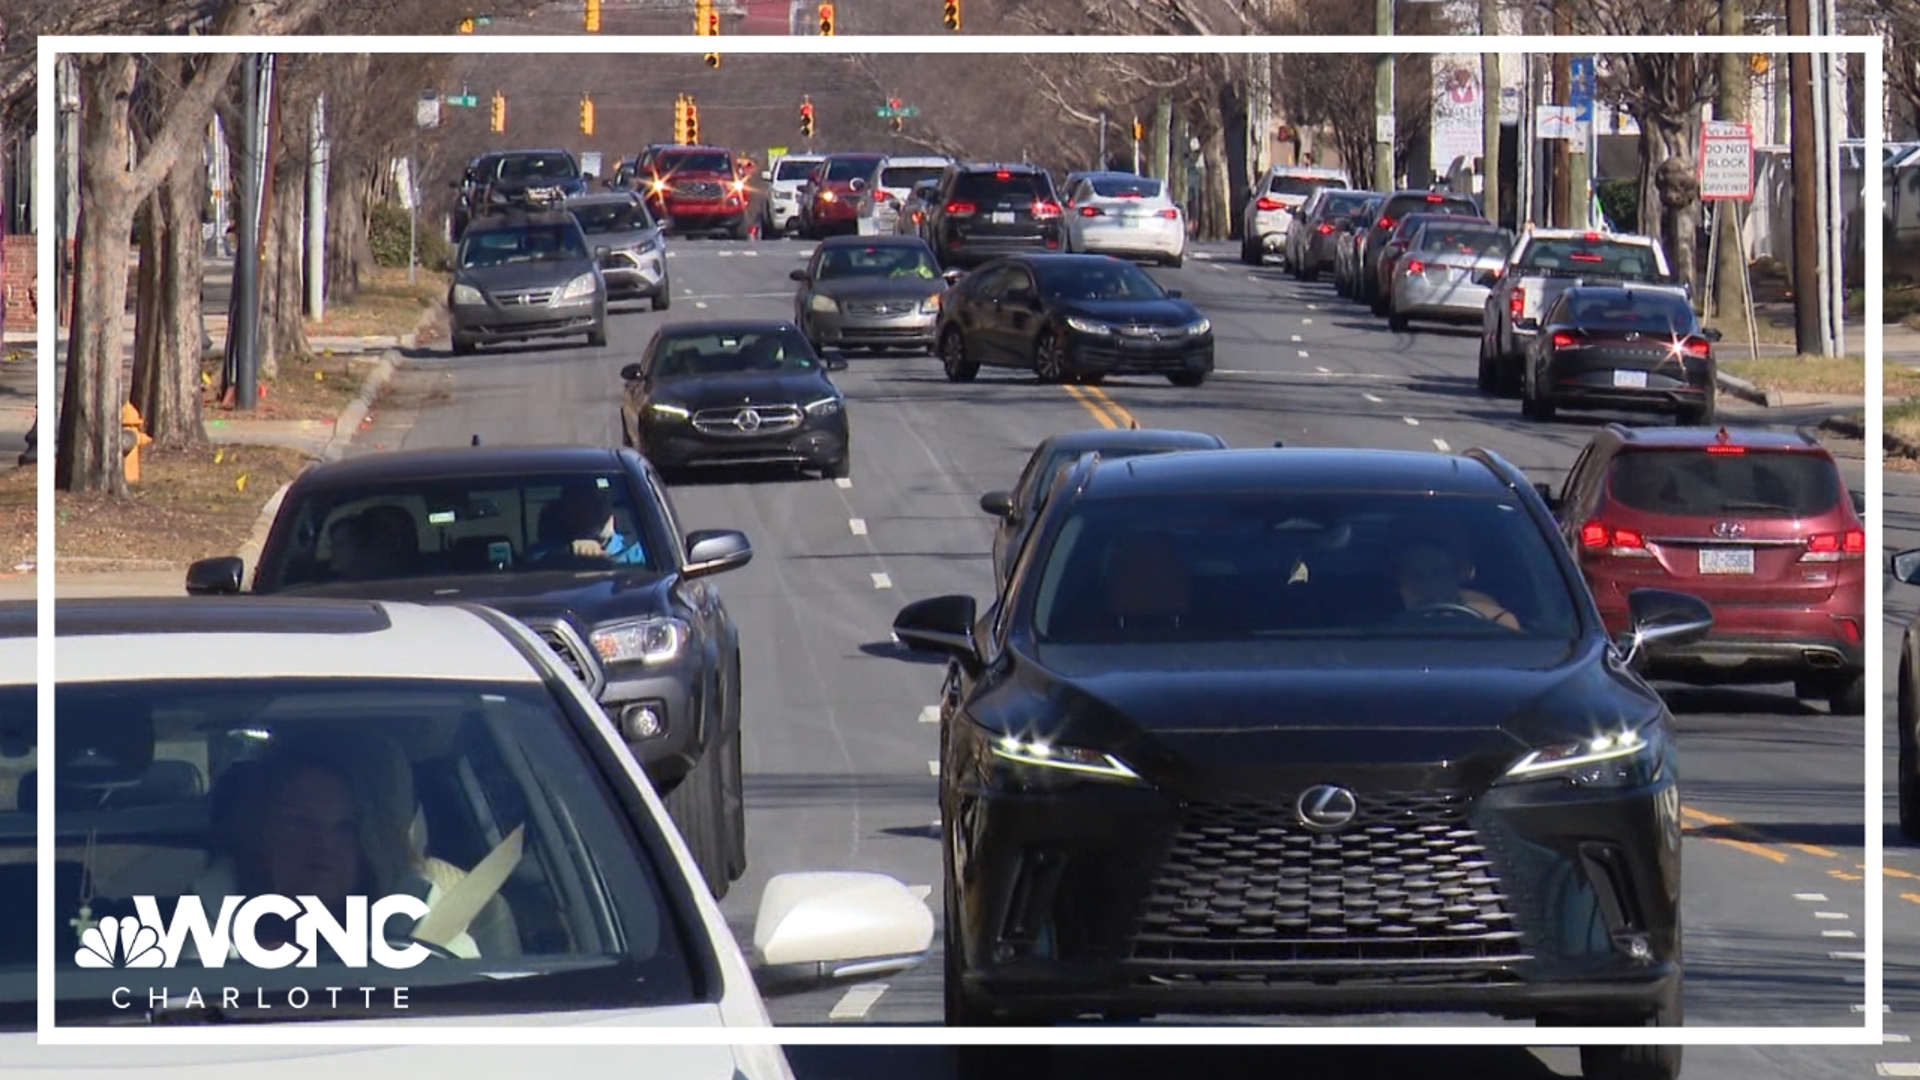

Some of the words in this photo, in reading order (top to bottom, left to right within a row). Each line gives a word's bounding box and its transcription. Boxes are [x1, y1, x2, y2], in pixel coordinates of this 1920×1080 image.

[1704, 144, 1721, 153] DO
[1726, 144, 1748, 153] NOT
[1708, 159, 1746, 168] BLOCK
